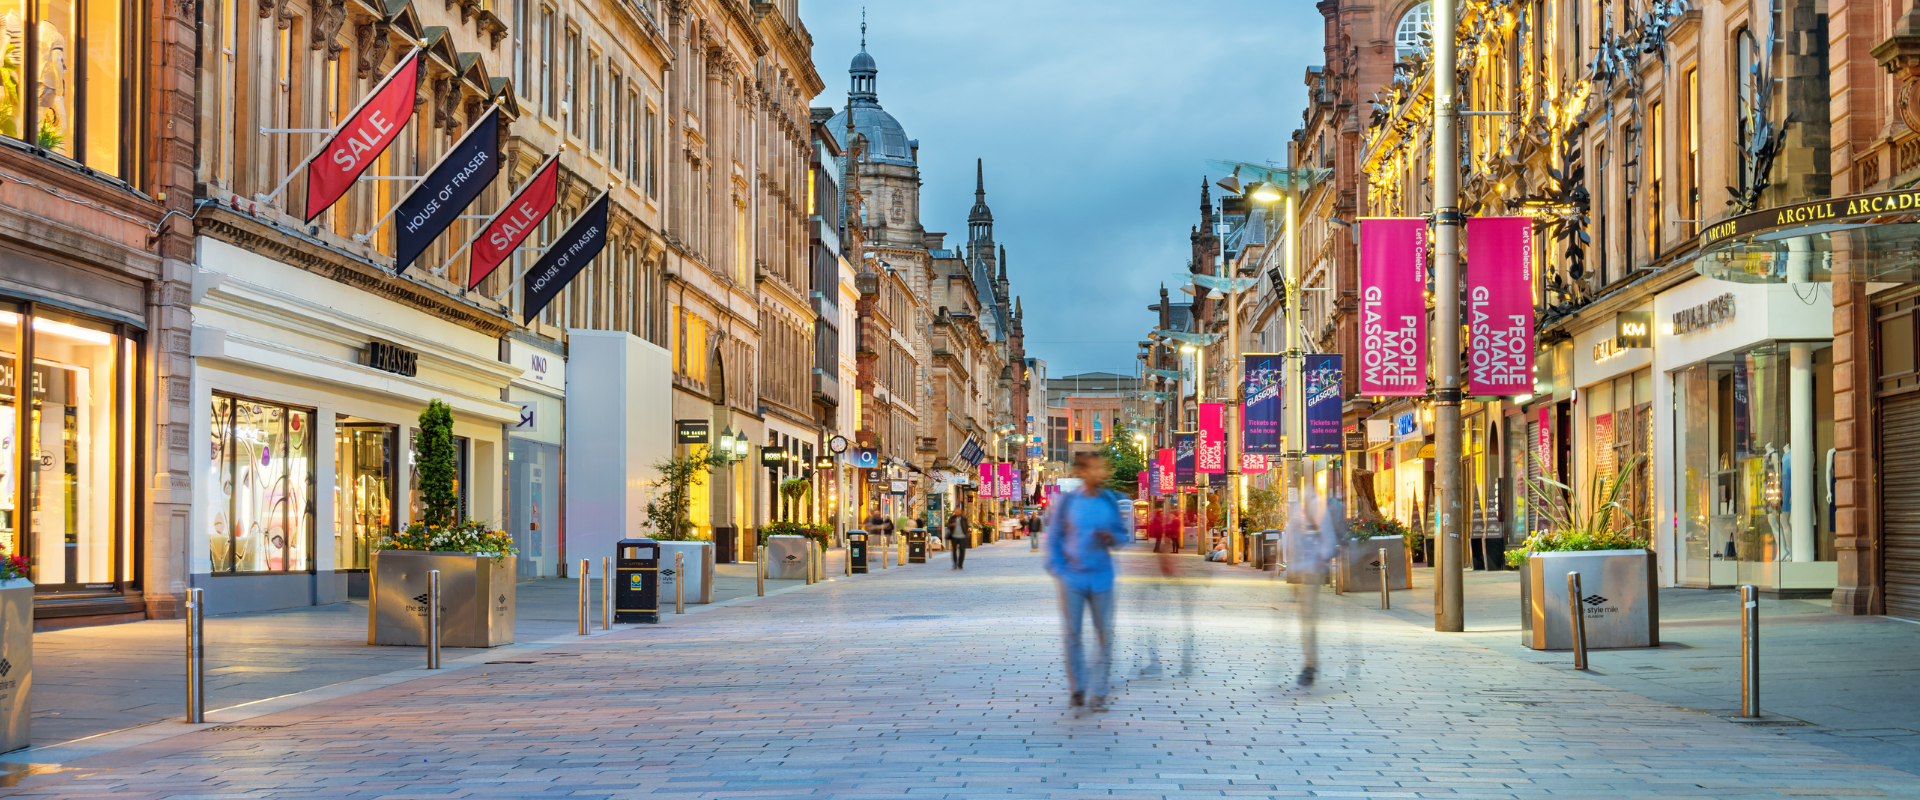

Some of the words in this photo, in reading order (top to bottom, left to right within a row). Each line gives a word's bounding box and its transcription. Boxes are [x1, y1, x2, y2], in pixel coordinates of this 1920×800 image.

[333, 109, 394, 172] SALE
[406, 198, 441, 234] HOUSE
[438, 184, 454, 201] OF
[451, 151, 489, 187] FRASER
[1777, 203, 1835, 225] ARGYLL
[1847, 192, 1920, 215] ARCADE
[490, 201, 539, 251] SALE
[1415, 228, 1423, 245] Let's
[1522, 226, 1530, 244] Let's
[1708, 220, 1737, 241] ARCADE
[531, 265, 560, 293] HOUSE
[557, 253, 570, 267] OF
[568, 226, 599, 256] FRASER
[1415, 246, 1423, 282] Celebrate
[1522, 244, 1530, 281] Celebrate
[1365, 286, 1382, 386] GLASGOW
[1472, 286, 1490, 385] GLASGOW
[1623, 322, 1645, 336] KM
[1673, 304, 1708, 336] MICHAEL
[374, 342, 418, 378] FRASERS
[531, 354, 547, 374] KIKO
[1382, 330, 1399, 386] MAKE
[1400, 315, 1417, 386] PEOPLE
[1491, 330, 1508, 385] MAKE
[1508, 315, 1526, 385] PEOPLE
[0, 364, 46, 393] CHEL
[1246, 384, 1277, 407] GLASGOW
[1308, 384, 1338, 407] GLASGOW
[1398, 412, 1414, 436] OFFICE
[1199, 429, 1207, 469] GLASGOW
[1206, 446, 1214, 469] MAKE
[1213, 440, 1221, 469] PEOPLE
[1249, 454, 1257, 469] AKE
[417, 605, 428, 613] sty
[1587, 606, 1604, 614] style
